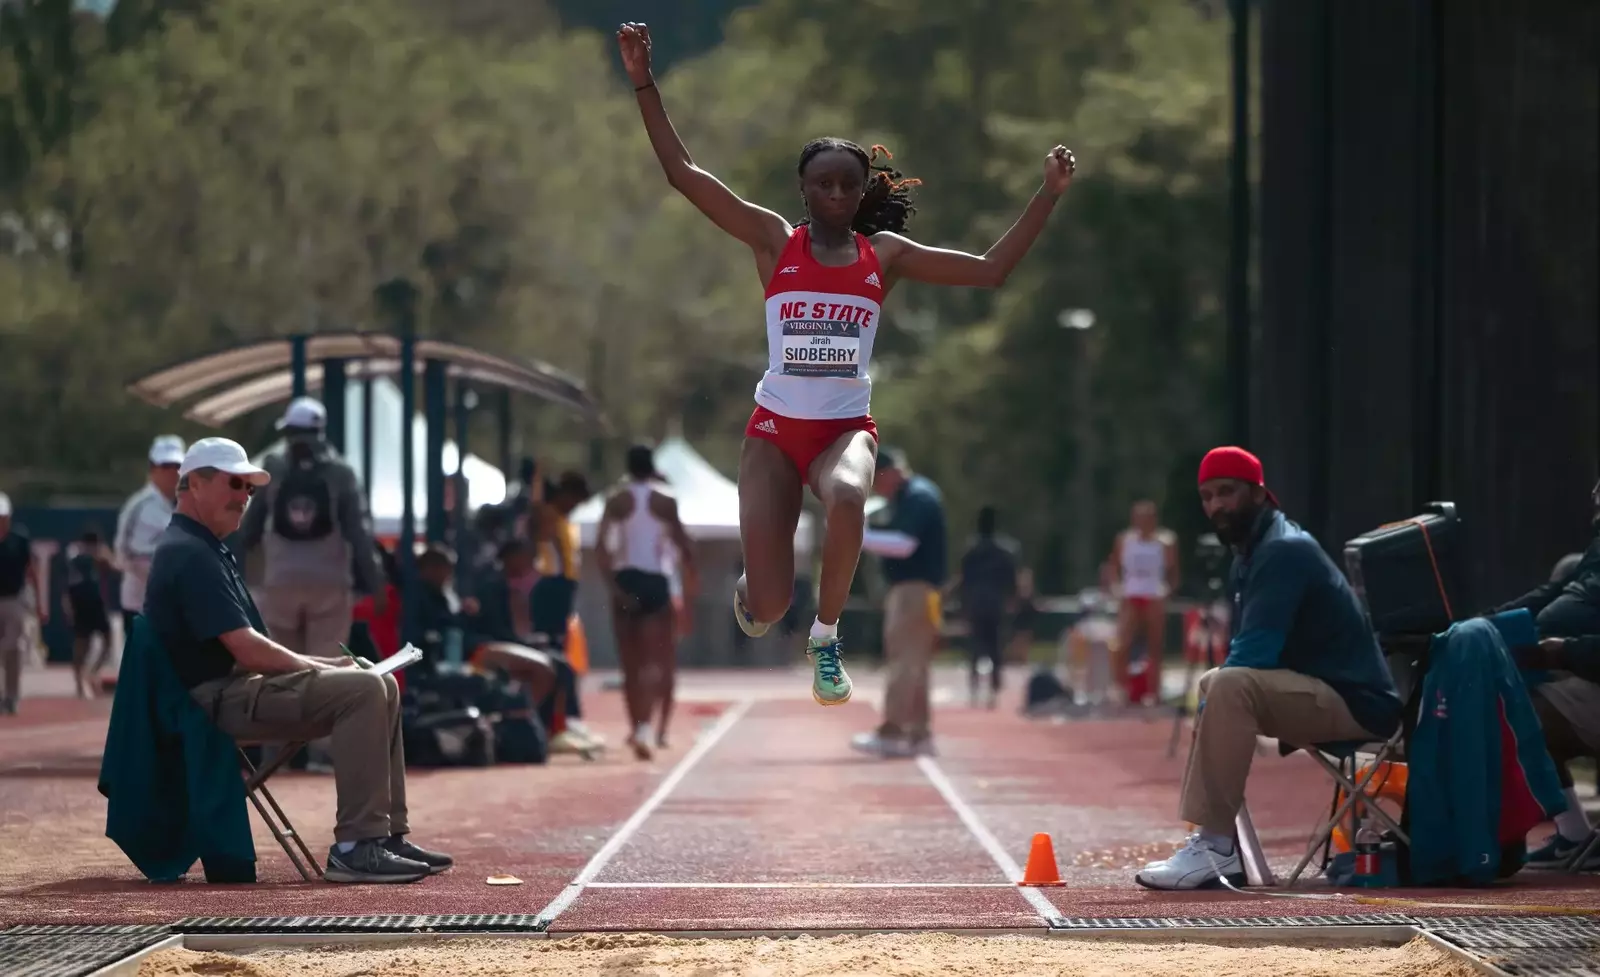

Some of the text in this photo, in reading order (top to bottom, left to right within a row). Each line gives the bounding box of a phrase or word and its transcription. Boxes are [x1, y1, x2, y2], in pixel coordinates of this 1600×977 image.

[779, 265, 800, 274] ACC
[780, 301, 874, 328] NC STATE
[789, 322, 833, 331] VIRGINIA
[810, 336, 831, 345] Jirah
[785, 347, 856, 362] SIDBERRY
[754, 424, 779, 435] adidas
